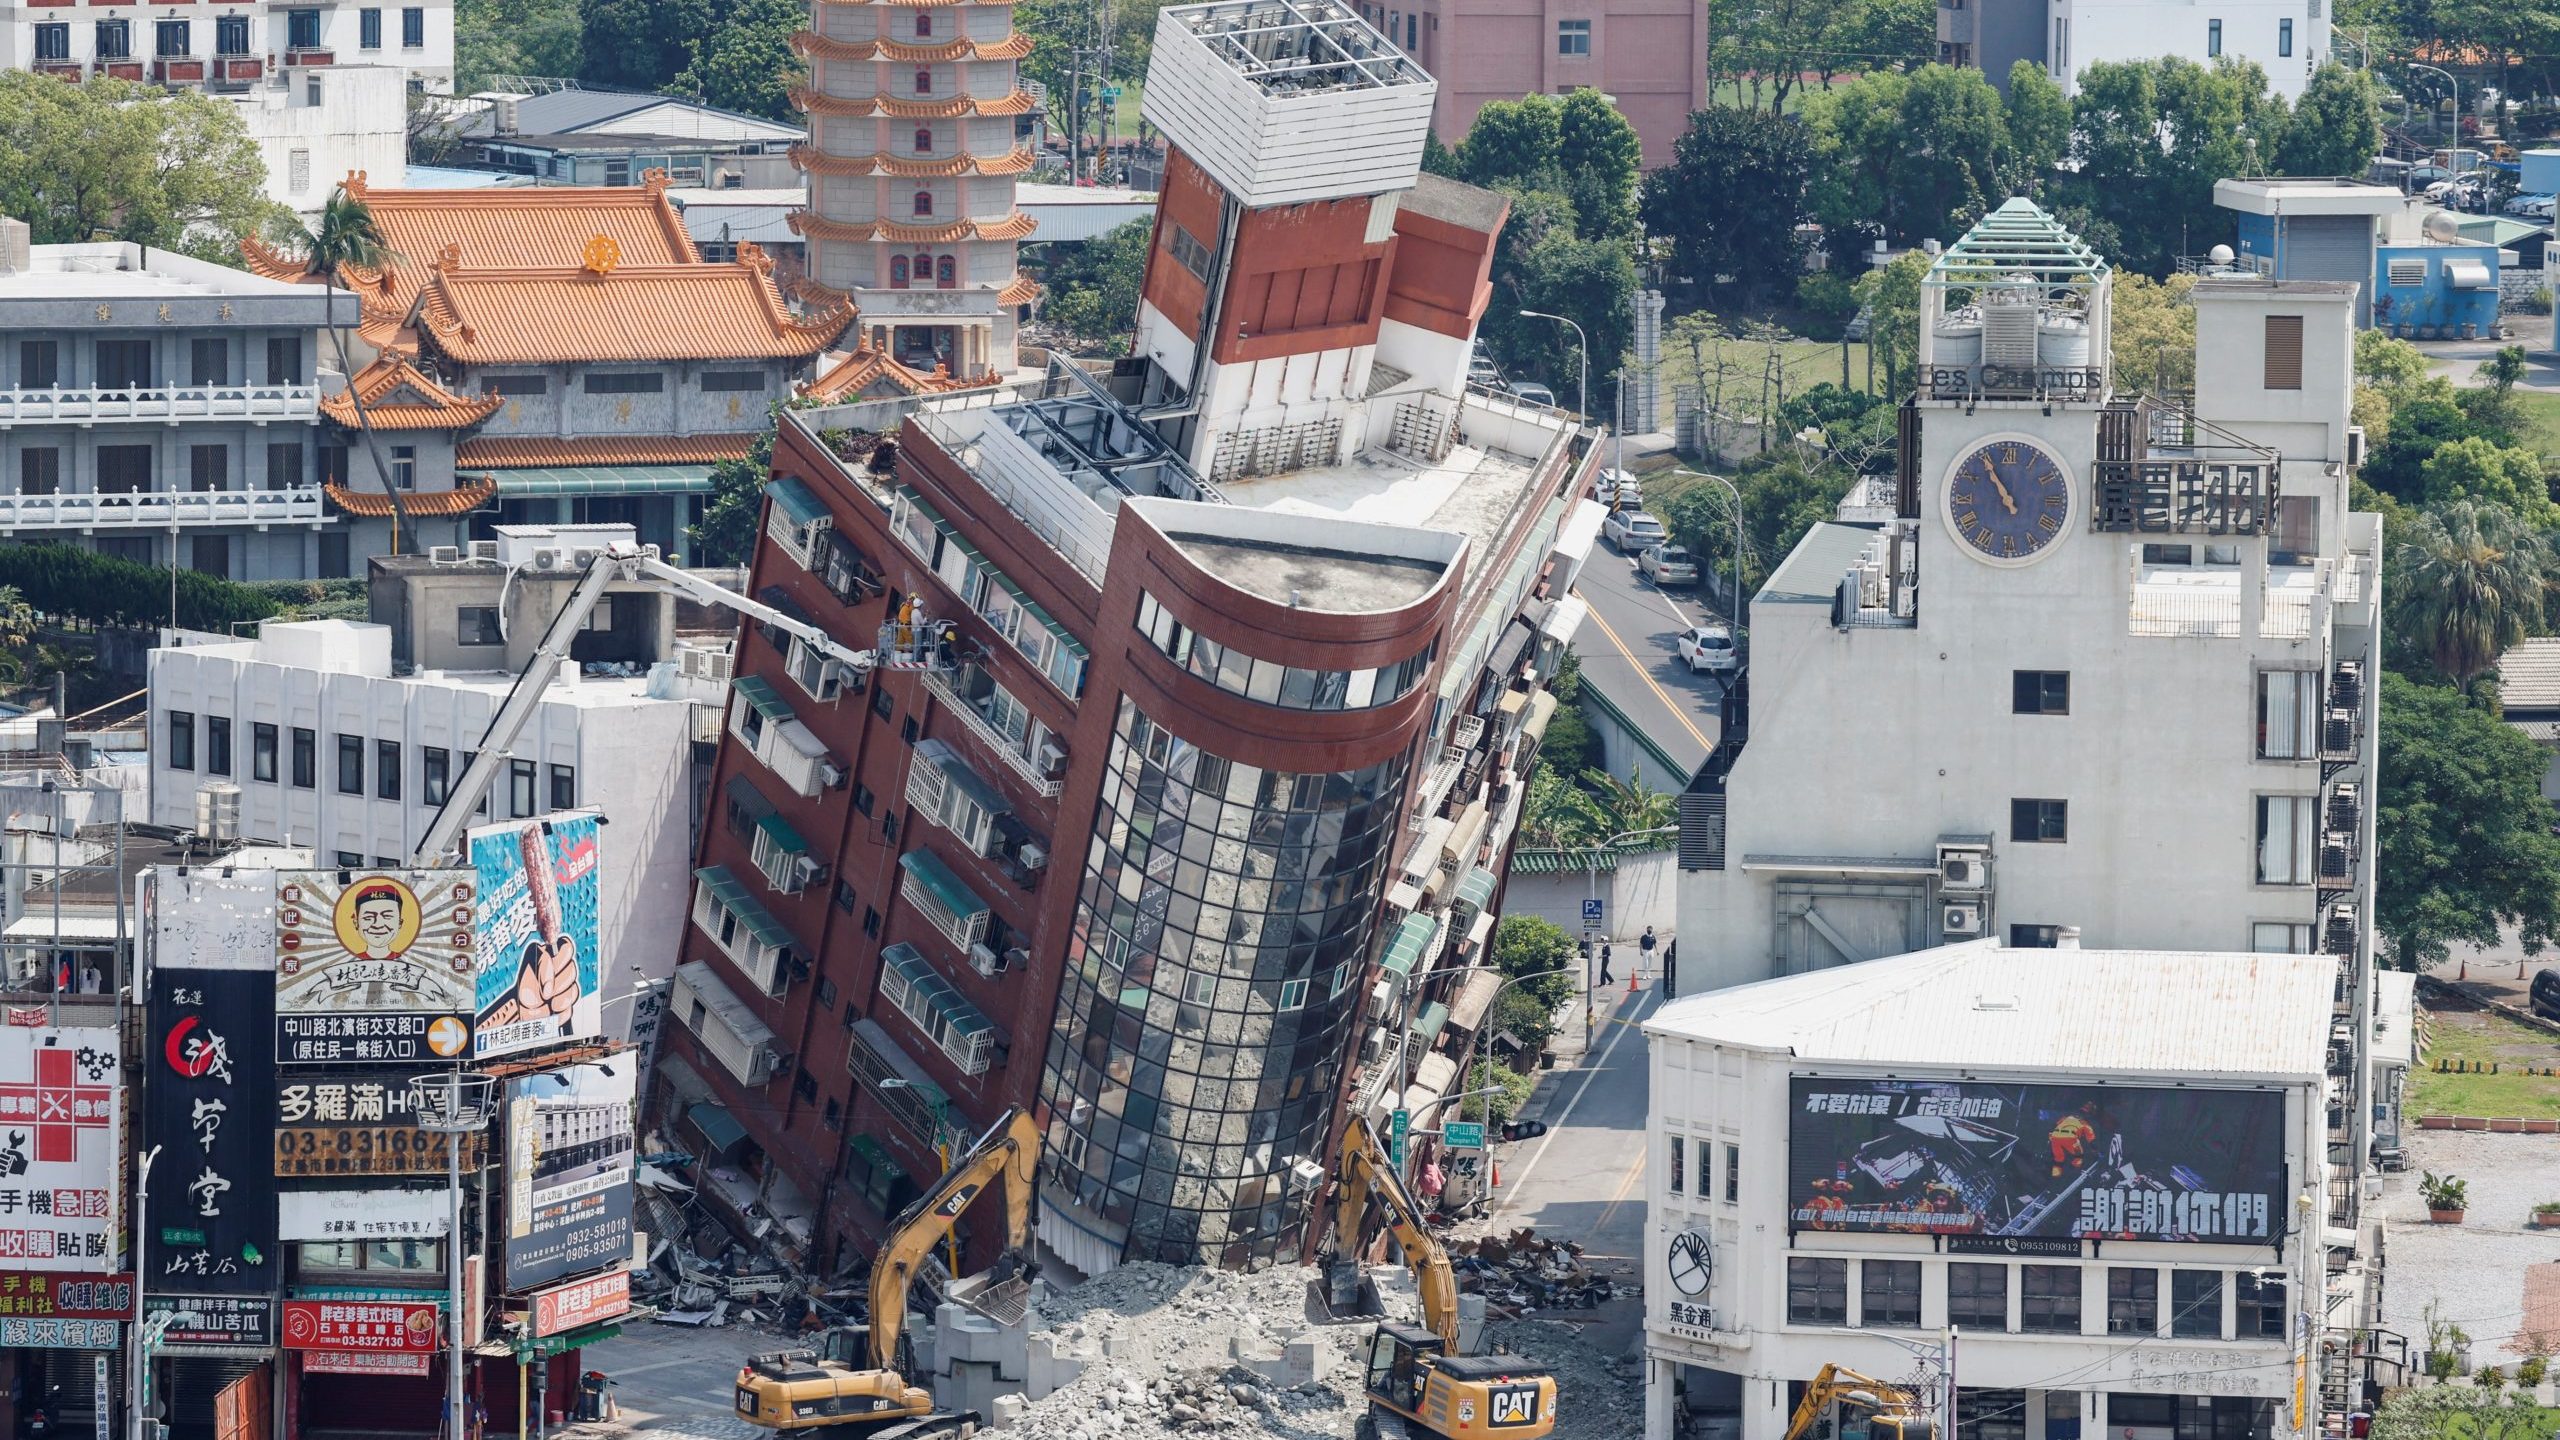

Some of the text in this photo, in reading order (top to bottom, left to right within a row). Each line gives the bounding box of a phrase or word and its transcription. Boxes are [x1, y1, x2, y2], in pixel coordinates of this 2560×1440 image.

[1980, 364, 2100, 396] Champs
[285, 1018, 425, 1036] 中山路北濱街交叉路口
[1806, 1093, 1891, 1115] 不要放棄
[1917, 1096, 2003, 1118] 花蓮加油
[279, 1130, 469, 1154] 03-8316622
[1449, 1125, 1479, 1136] 中山路
[947, 1191, 966, 1213] CAT
[2080, 1187, 2268, 1237] 謝謝你們
[567, 1217, 627, 1246] 0932-581018
[566, 1233, 626, 1263] 0905-935071
[2020, 1241, 2079, 1252] 0955109812
[4, 1276, 46, 1293] 手機
[58, 1281, 130, 1311] 收購維修
[173, 1313, 260, 1331] 機山苦瓜
[320, 1305, 404, 1324] 胖老爹美式炸雞
[1670, 1302, 1711, 1328] 黑金通
[5, 1320, 115, 1347] 緣來檳榔
[342, 1336, 404, 1347] 03-8327130
[740, 1391, 753, 1410] CAT
[873, 1400, 888, 1410] CAT
[1493, 1391, 1535, 1423] CAT
